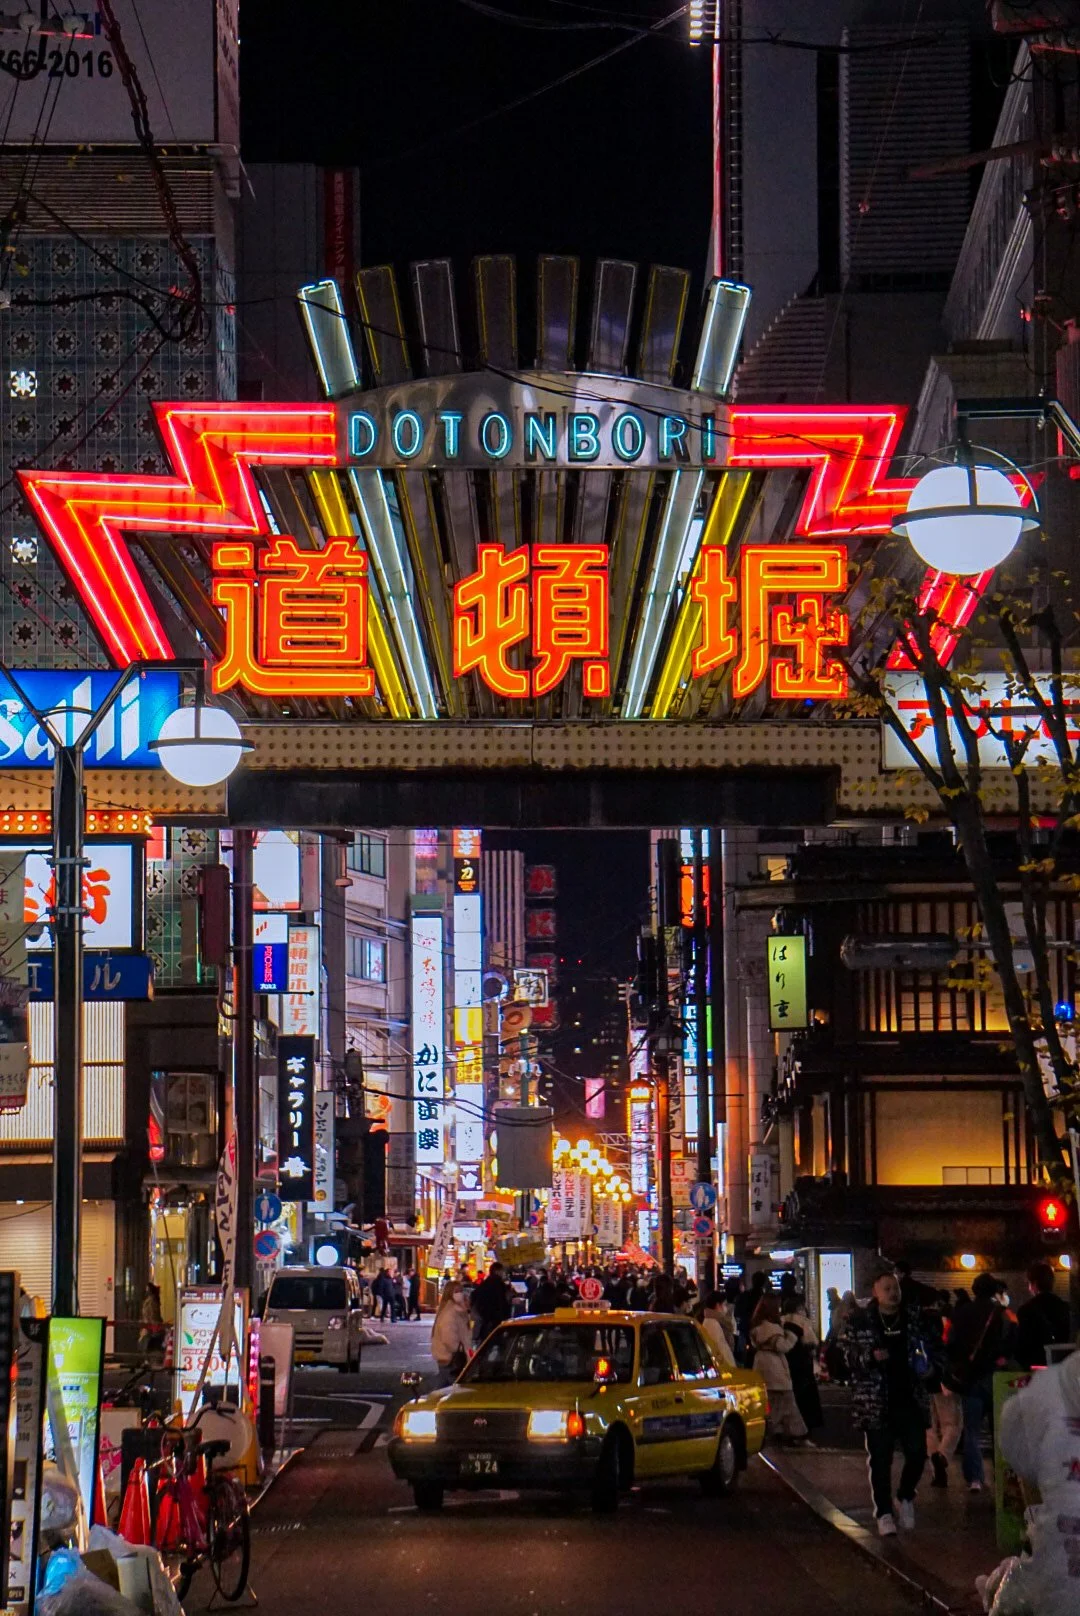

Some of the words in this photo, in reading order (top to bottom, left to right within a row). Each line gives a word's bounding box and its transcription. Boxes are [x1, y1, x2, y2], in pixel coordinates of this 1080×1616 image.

[0, 49, 113, 78] 66-2016
[349, 411, 715, 460] DOTONBORI
[212, 535, 848, 699] 道頓堀
[264, 945, 273, 983] PROMISE
[772, 944, 790, 1019] はり重
[286, 1057, 306, 1147] ギャラリー
[417, 1043, 439, 1150] かに道楽
